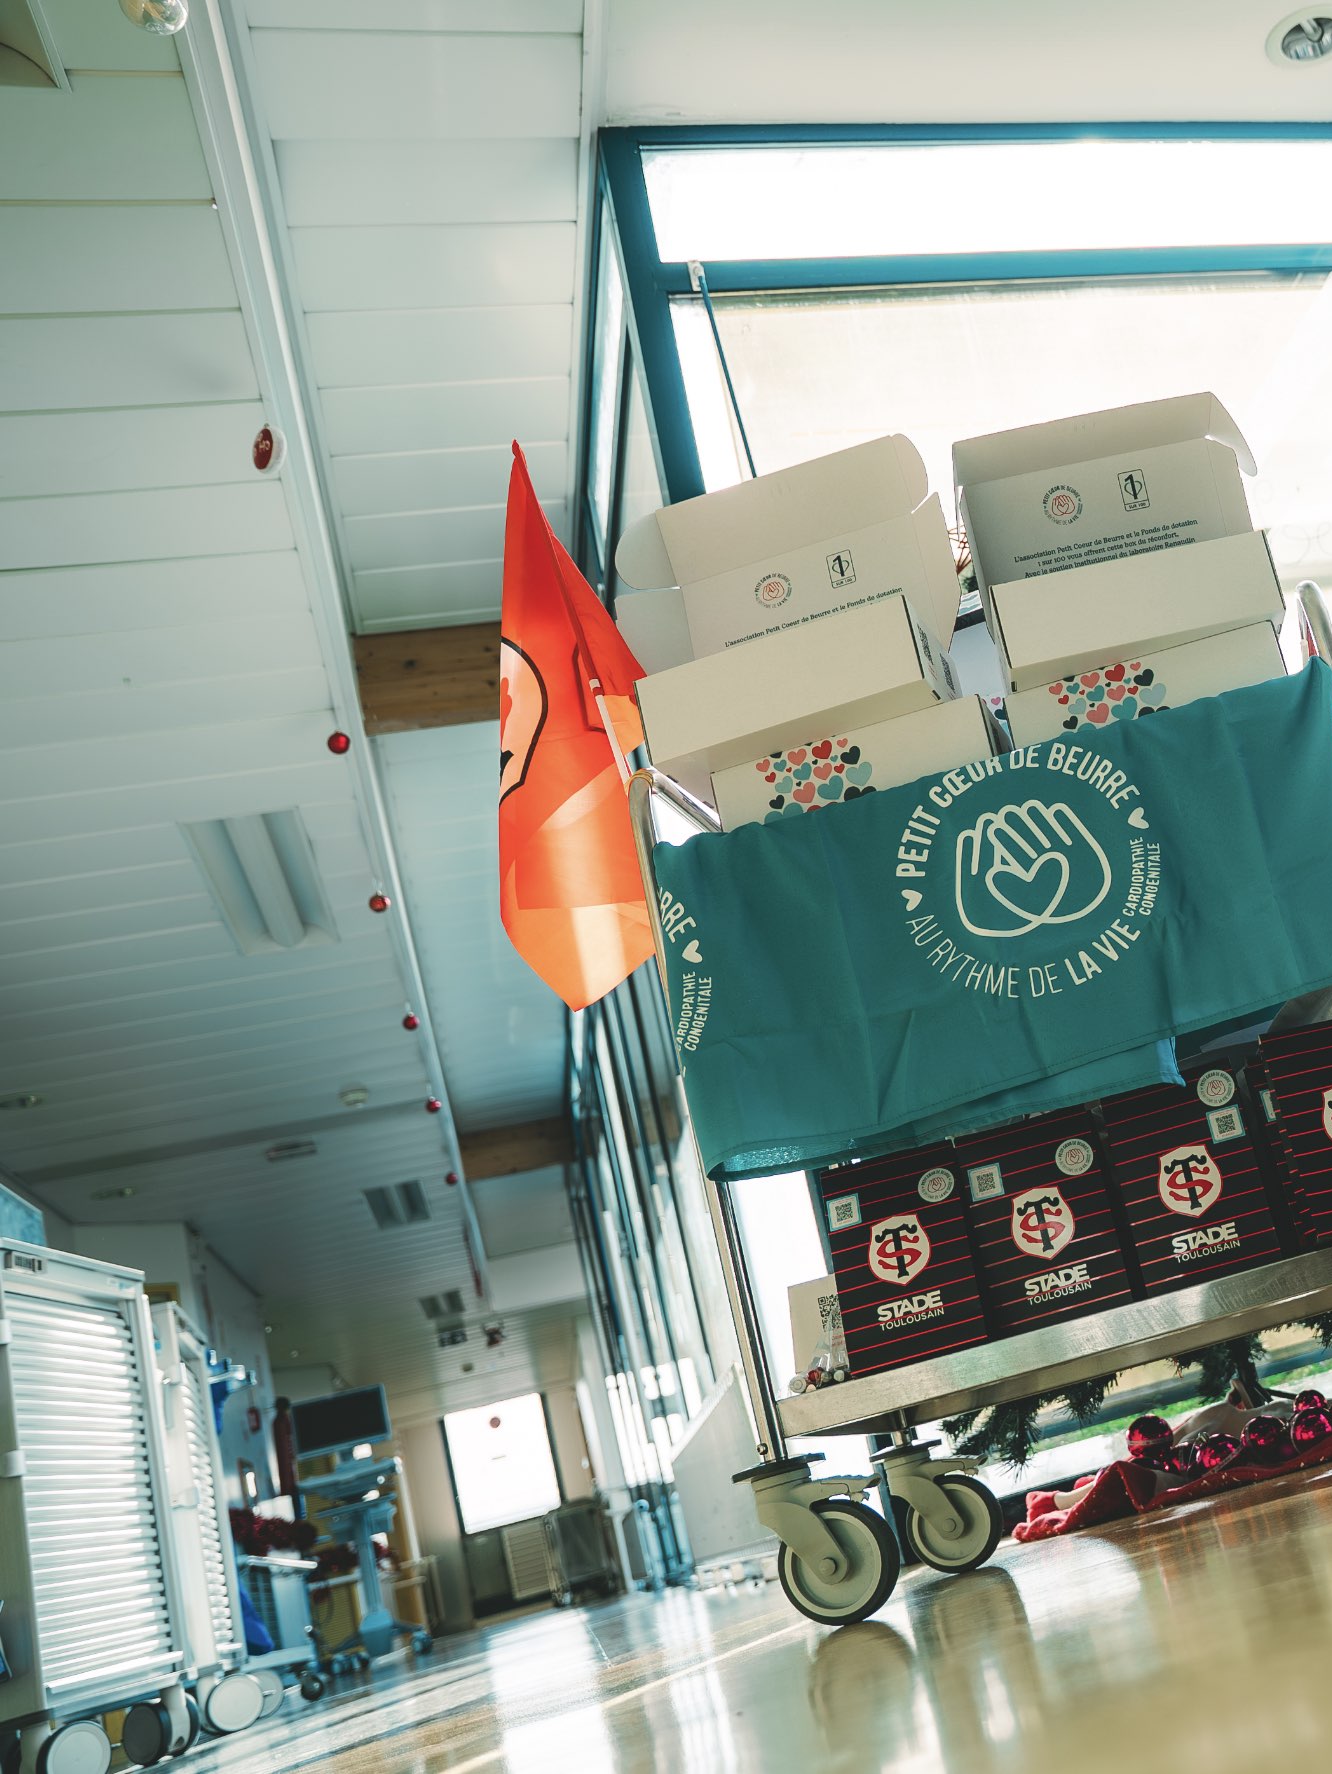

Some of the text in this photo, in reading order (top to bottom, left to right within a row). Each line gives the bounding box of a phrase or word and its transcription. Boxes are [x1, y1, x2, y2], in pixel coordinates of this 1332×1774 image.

[1014, 549, 1056, 563] L'association
[1057, 544, 1072, 554] Petit
[1074, 540, 1092, 550] Coeur
[1094, 538, 1102, 546] de
[1104, 534, 1125, 544] Beurre
[1141, 526, 1161, 536] Fonds
[1162, 524, 1170, 532] de
[1171, 518, 1198, 530] dotation
[1054, 556, 1066, 564] 100
[1084, 547, 1106, 558] offrent
[1107, 543, 1124, 552] cette
[1124, 540, 1137, 549] box
[1024, 571, 1041, 579] Avec
[1049, 563, 1073, 574] soutien
[1074, 553, 1118, 569] institutionnel
[1129, 544, 1164, 556] laboratoire
[725, 631, 764, 648] L'association
[765, 625, 780, 635] Petit
[781, 619, 800, 630] Coeur
[810, 609, 831, 620] Beurre
[847, 598, 866, 608] Fonds
[876, 587, 902, 600] dotation
[896, 742, 1140, 877] PETIT CŒUR DE BEURRE
[1122, 836, 1145, 916] CARDIOPATHIE
[1138, 842, 1161, 916] CONGENITALE
[905, 915, 1141, 998] AU RYTHME DE LA VIE
[1172, 1222, 1238, 1254] STADE
[1175, 1240, 1241, 1264] TOULOUSAIN
[1024, 1263, 1090, 1296] STADE
[1028, 1282, 1092, 1306] TOULOUSAIN
[877, 1290, 943, 1321] STADE
[880, 1308, 944, 1331] TOULOUSAIN
